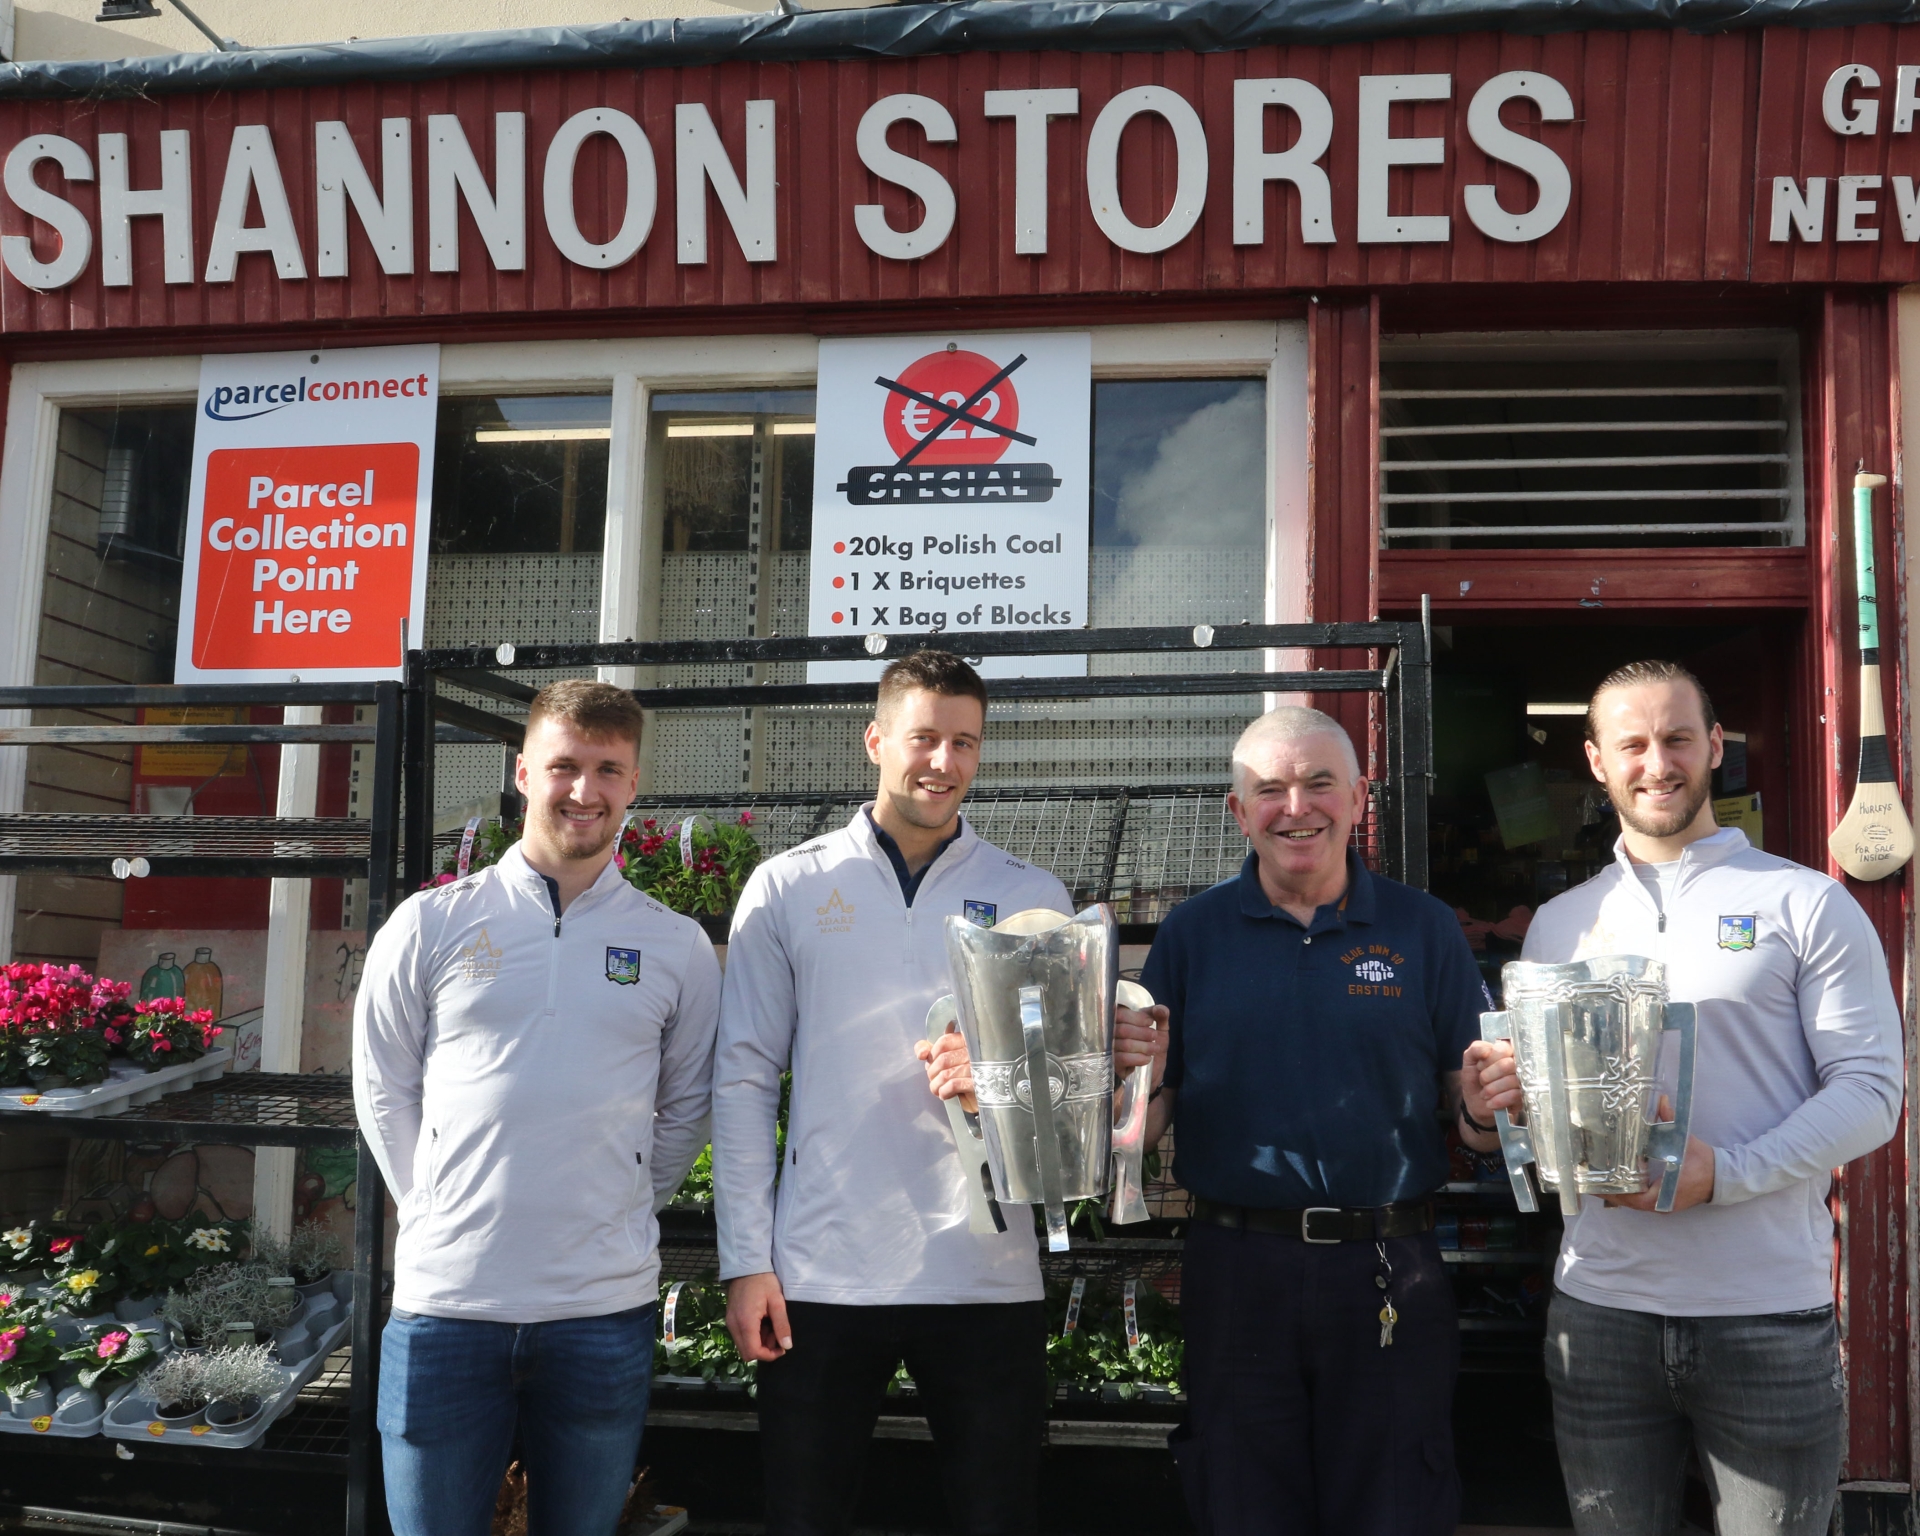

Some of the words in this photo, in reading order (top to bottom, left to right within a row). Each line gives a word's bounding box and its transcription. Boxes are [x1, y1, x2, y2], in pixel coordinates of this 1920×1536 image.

[1, 99, 777, 291] SHANNON
[854, 70, 1575, 260] STORES
[212, 373, 429, 414] parcelconnect
[901, 390, 1001, 441] €22
[248, 469, 375, 509] Parcel
[867, 470, 1028, 499] SPECIAL
[208, 512, 408, 552] Collection
[849, 535, 913, 561] 20kg
[923, 533, 997, 555] Polish
[1006, 533, 1062, 554] Coal
[252, 555, 360, 593] Point
[850, 572, 860, 591] 1
[871, 571, 891, 591] X
[900, 569, 1026, 596] Briquettes
[252, 600, 352, 634] Here
[850, 607, 859, 626] 1
[871, 606, 890, 626] X
[899, 606, 947, 631] Bag
[956, 604, 983, 625] of
[991, 603, 1072, 625] Blocks
[1859, 853, 1891, 863] INSIDE
[1874, 844, 1895, 853] SALE
[1005, 859, 1026, 870] DM
[815, 916, 855, 927] ADARE
[1355, 960, 1392, 972] SUPPLY
[1355, 970, 1395, 982] STUDIO
[1348, 984, 1380, 996] EAST
[1383, 985, 1402, 998] DIV
